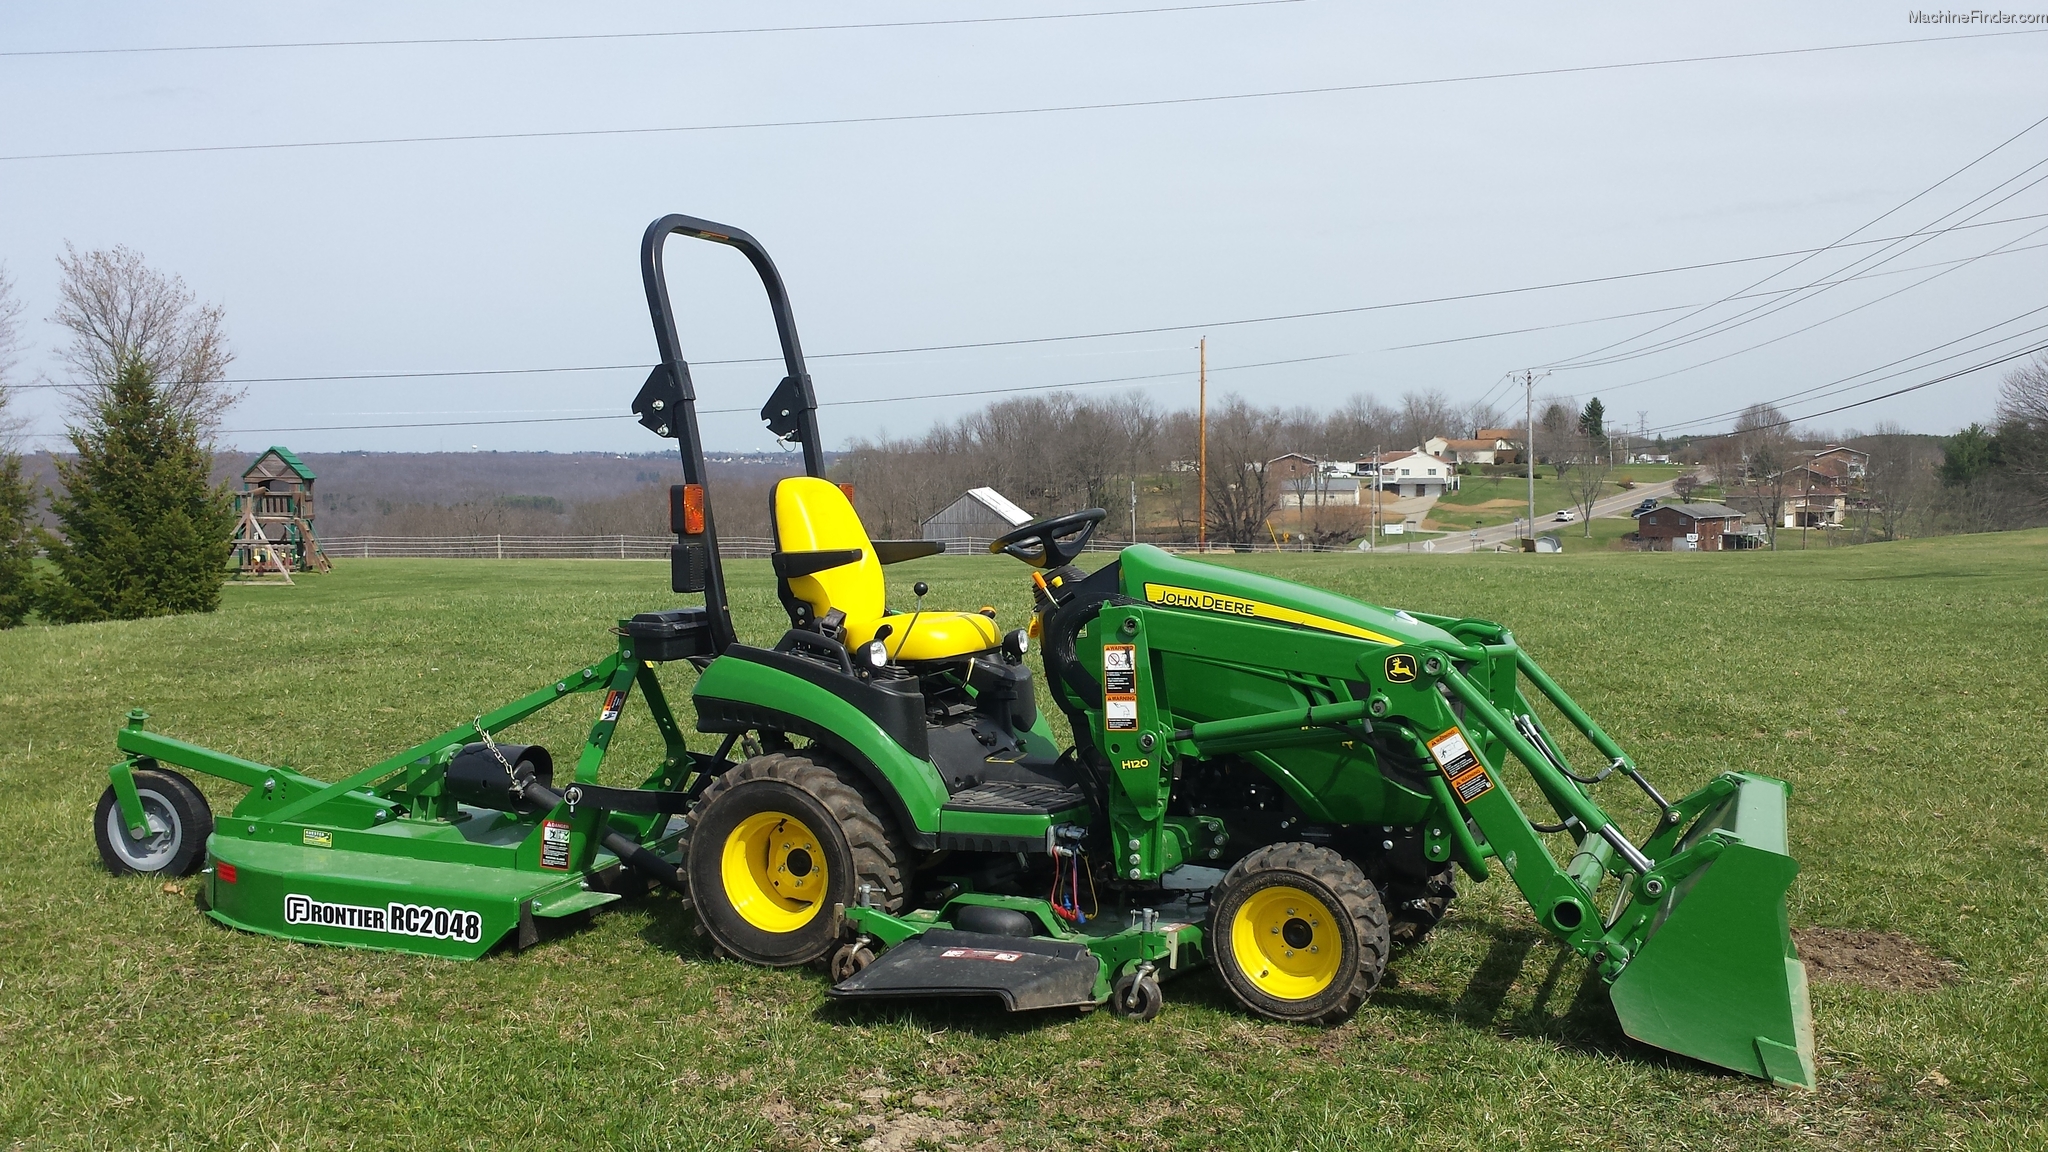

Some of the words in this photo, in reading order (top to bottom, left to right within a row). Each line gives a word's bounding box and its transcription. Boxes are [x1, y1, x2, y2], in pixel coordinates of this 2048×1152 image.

[1156, 590, 1198, 607] JOHN
[1201, 595, 1255, 615] DEERE
[1121, 759, 1149, 770] H120
[286, 896, 385, 930] FRONTIER
[391, 905, 480, 941] RC2048
